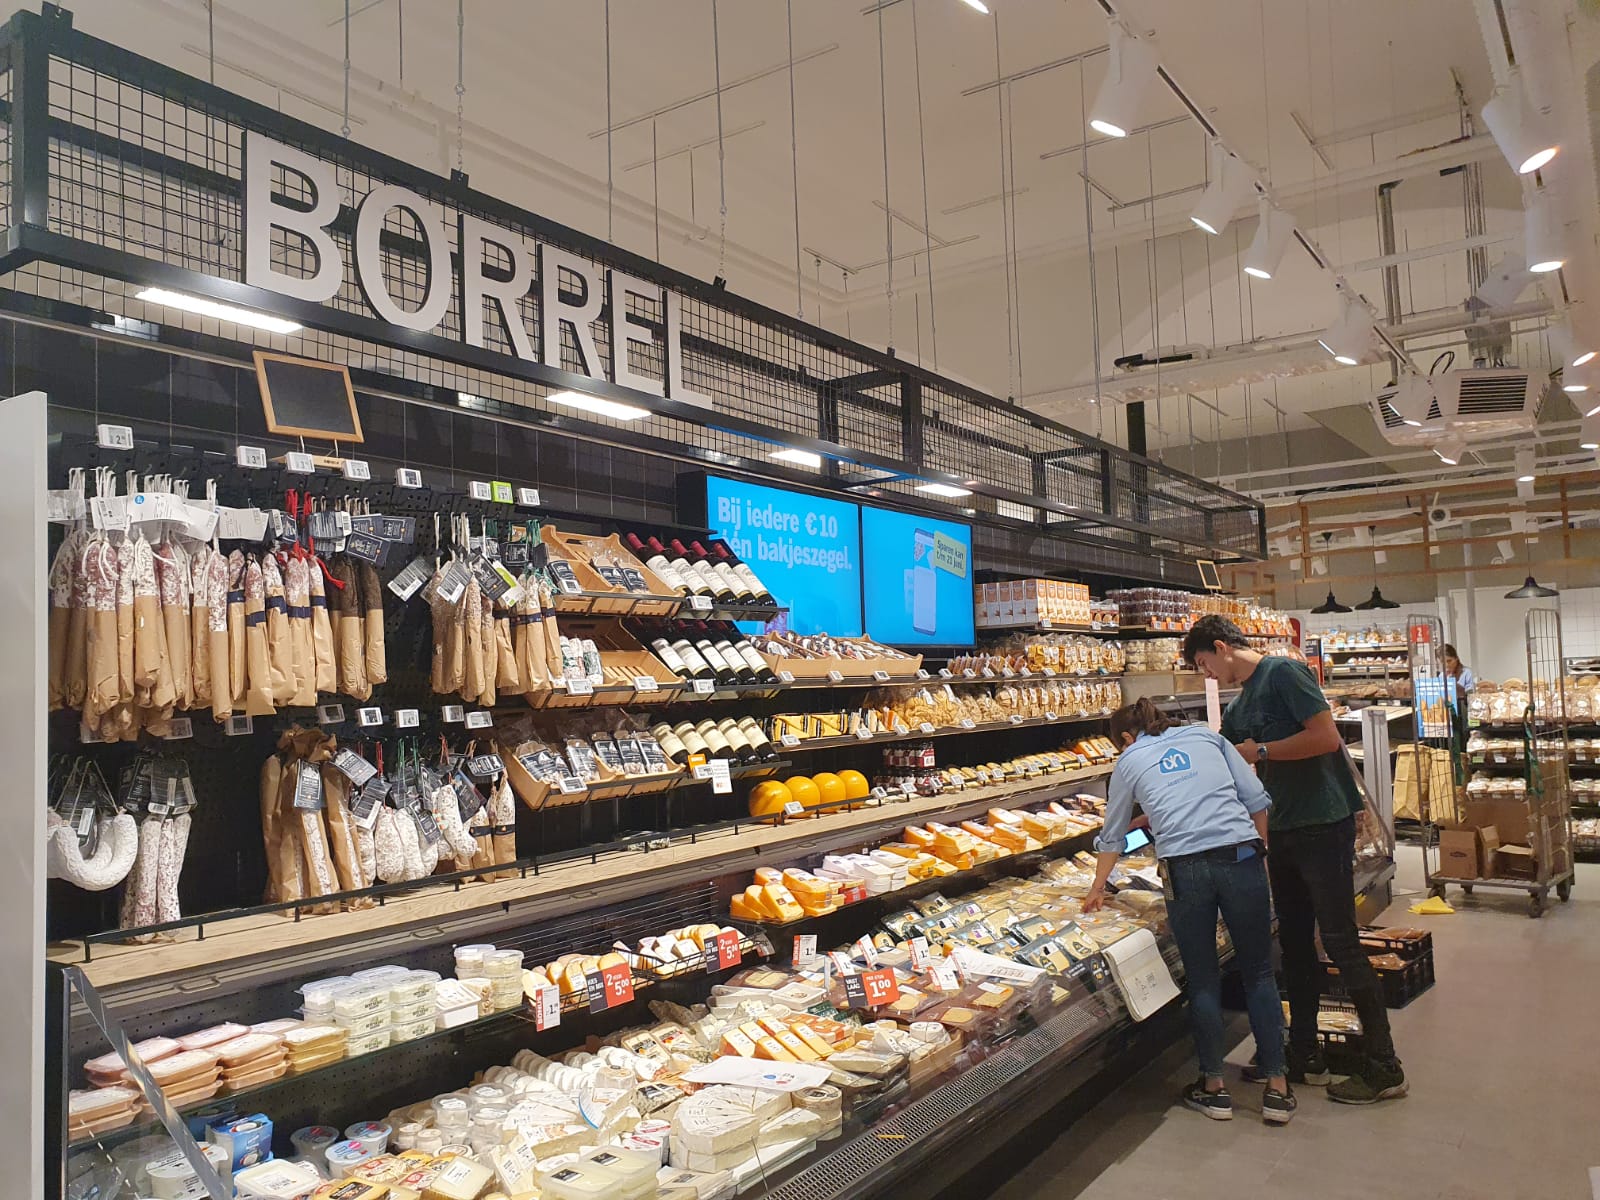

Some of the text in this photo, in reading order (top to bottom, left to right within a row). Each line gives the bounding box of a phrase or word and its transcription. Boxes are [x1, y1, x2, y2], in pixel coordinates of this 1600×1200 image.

[243, 128, 712, 410] BORREL
[718, 496, 741, 531] Bij
[747, 500, 800, 533] iedere
[758, 534, 852, 574] bakjeszegel.
[720, 938, 726, 950] 2
[606, 973, 613, 986] 2
[614, 978, 630, 996] 5.00
[869, 978, 891, 998] 1.00
